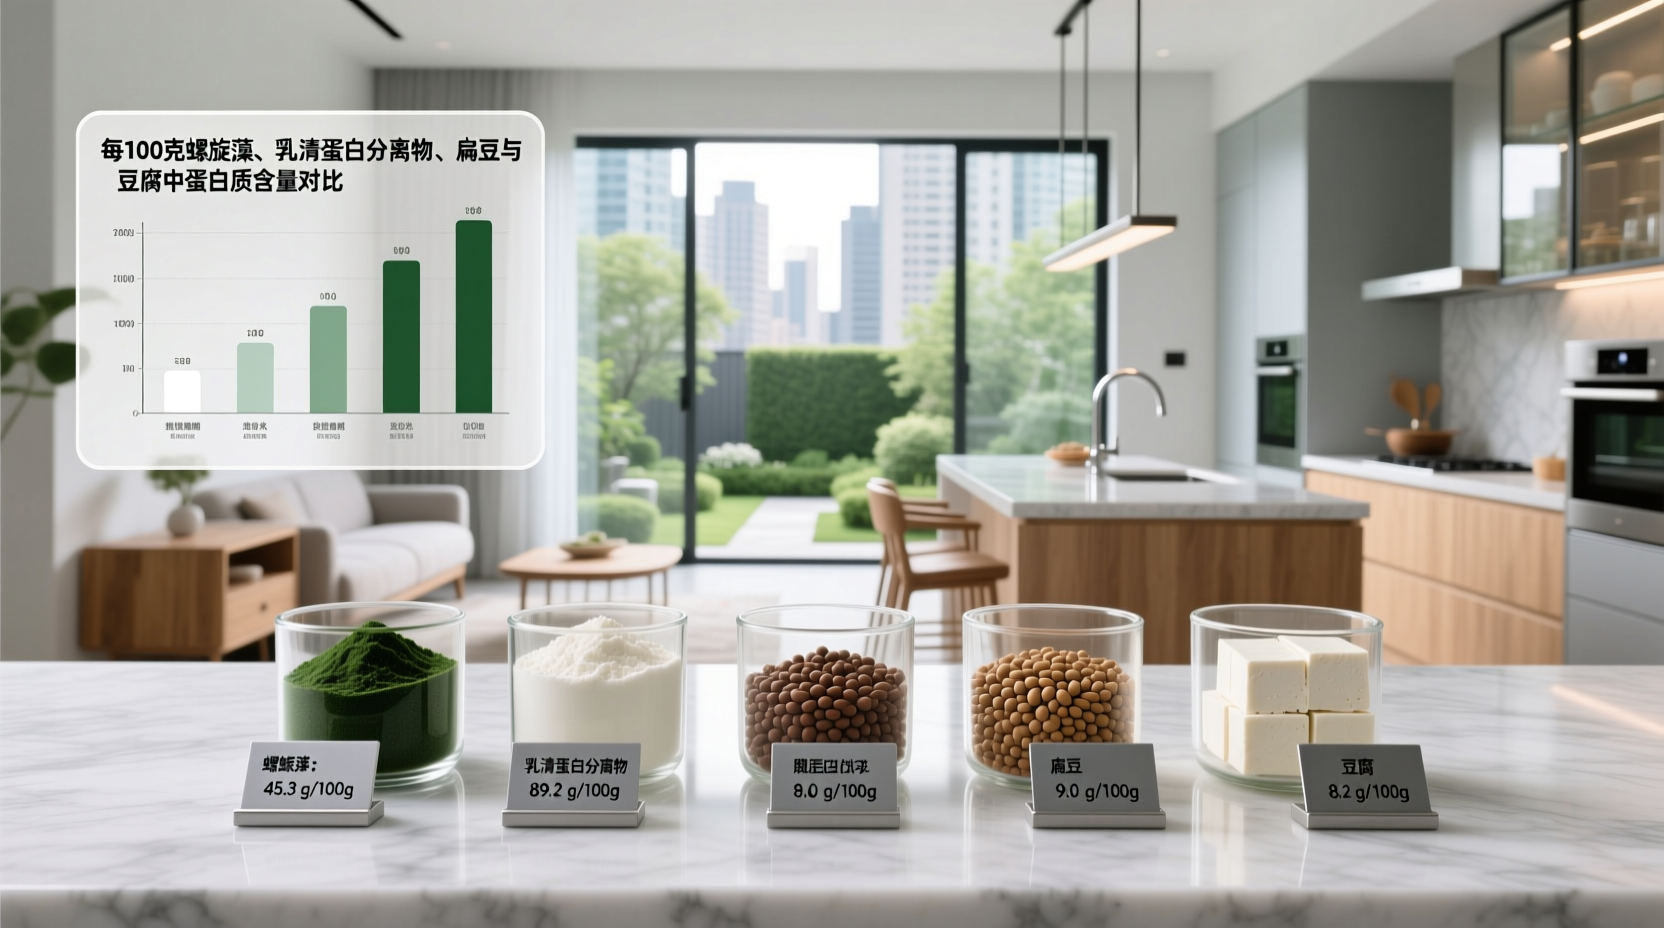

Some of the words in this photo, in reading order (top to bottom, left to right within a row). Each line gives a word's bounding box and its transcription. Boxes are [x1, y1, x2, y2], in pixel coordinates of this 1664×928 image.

[1341, 758, 1374, 776] 豆腐
[263, 781, 297, 796] 45.3
[300, 781, 354, 800] g/100g
[529, 782, 563, 798] 89.2
[567, 782, 620, 801] g/100g
[793, 783, 819, 799] 8.0
[823, 783, 877, 802] g/100g
[1055, 783, 1080, 798] 9.0
[1085, 782, 1139, 802] g/100g
[1328, 783, 1352, 799] 8.2
[1355, 783, 1410, 803] g/100g
